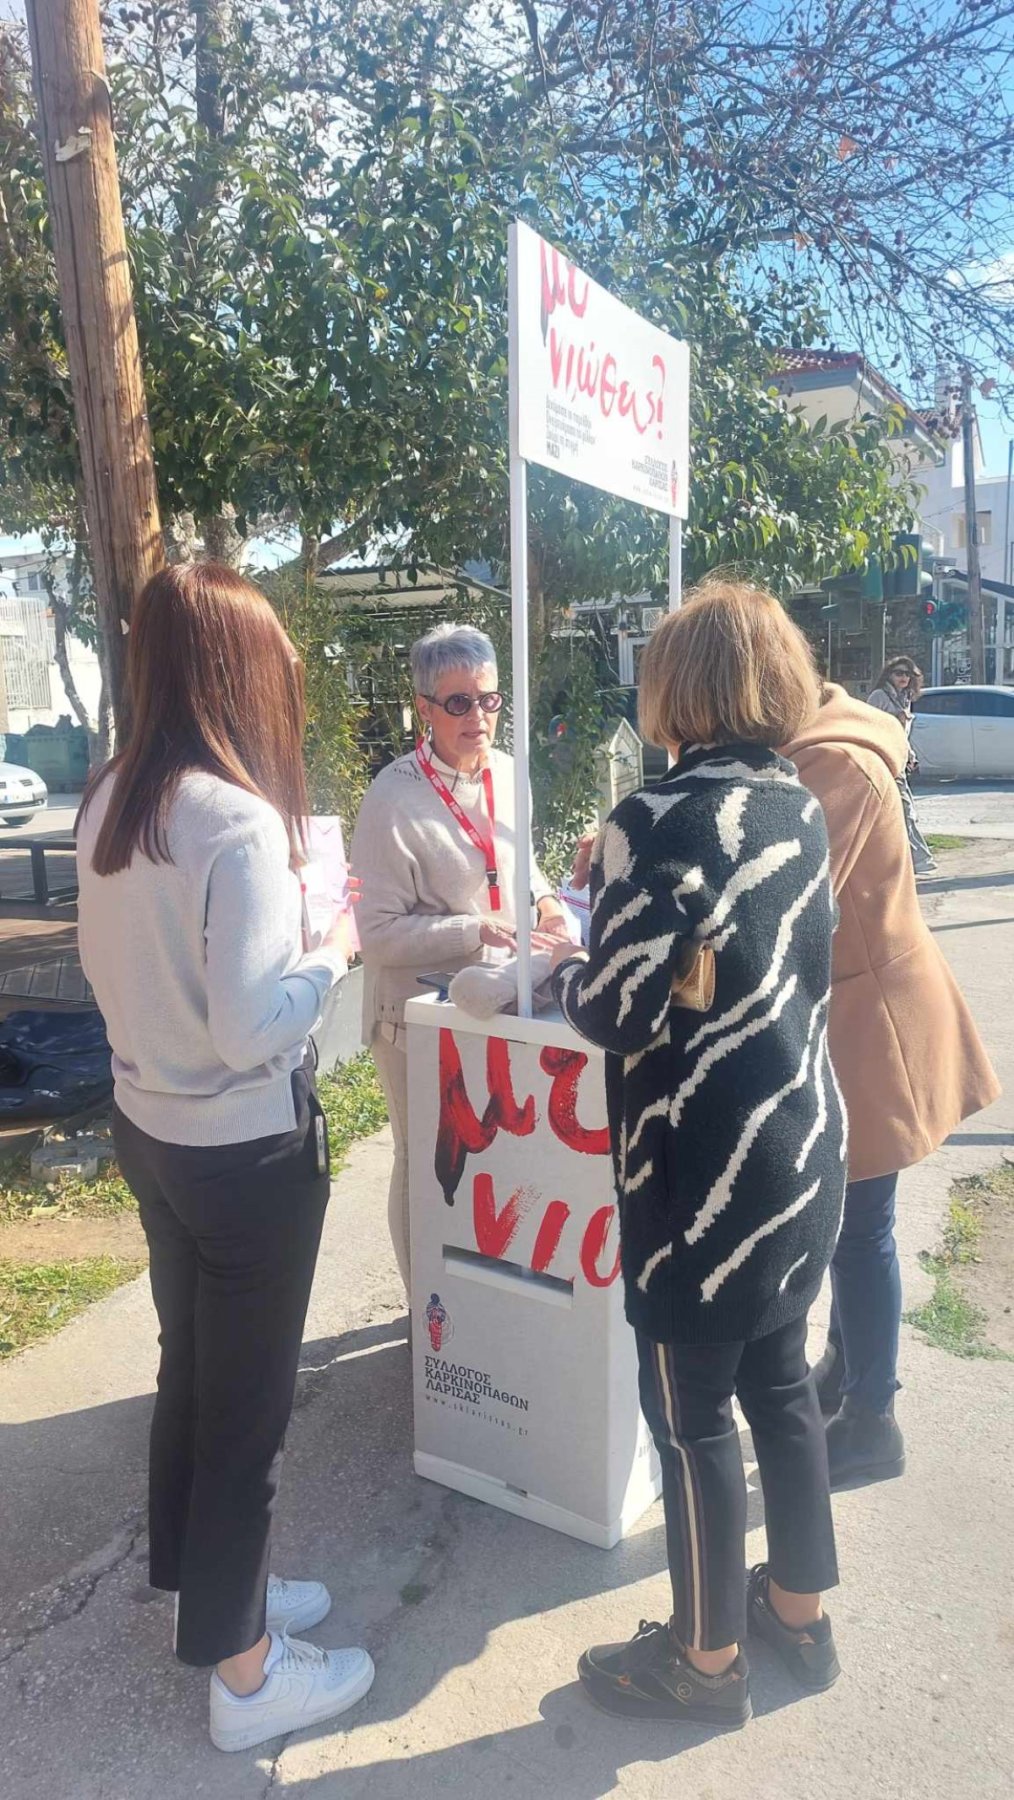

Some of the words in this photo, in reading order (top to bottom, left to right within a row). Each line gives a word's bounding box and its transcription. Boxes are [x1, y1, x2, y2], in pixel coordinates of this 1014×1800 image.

[424, 1355, 492, 1386] ΣΥΛΛΟΓΟΣ
[424, 1366, 529, 1411] ΚΑΡΚΙΝΟΠΑΘΩΝ
[425, 1379, 481, 1405] ΛΑΡΙΣΑΣ
